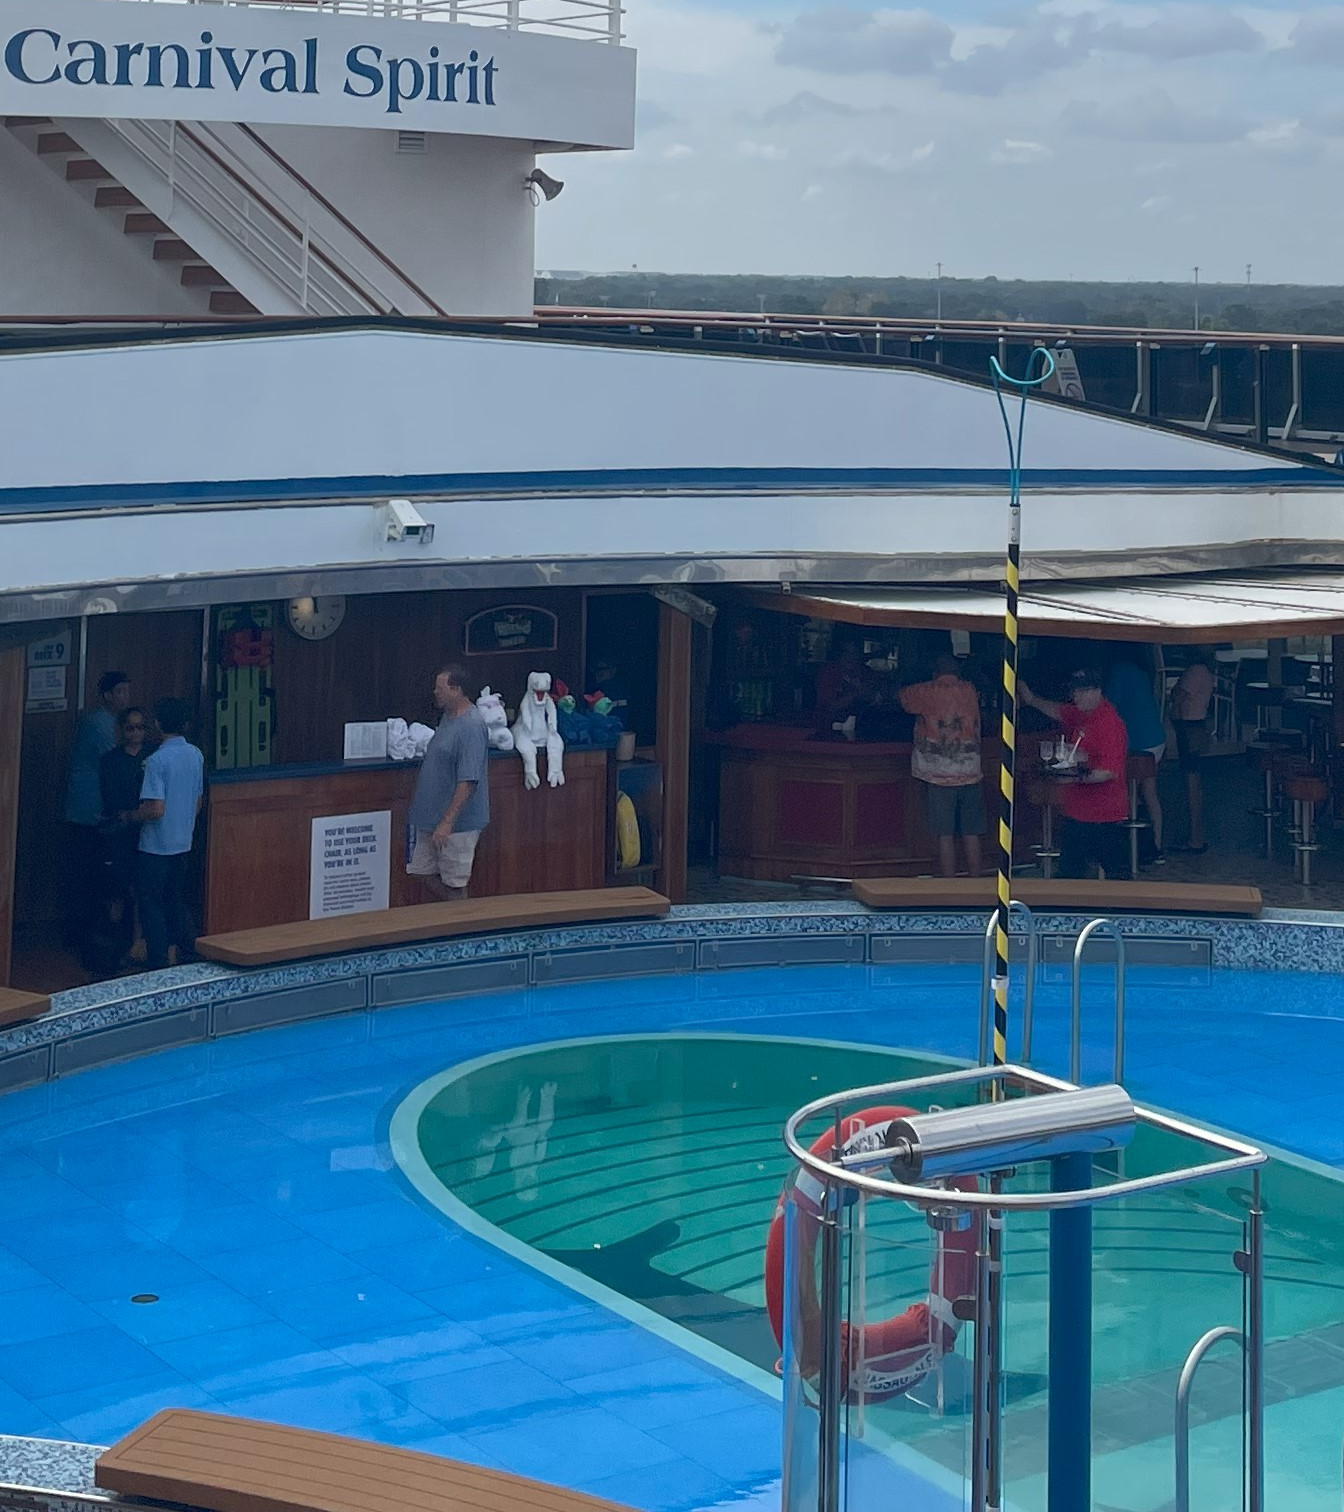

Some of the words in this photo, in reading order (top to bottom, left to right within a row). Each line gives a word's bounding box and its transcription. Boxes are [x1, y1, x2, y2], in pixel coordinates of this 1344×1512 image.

[4, 28, 319, 94] Carnival
[343, 44, 499, 114] Spirit
[56, 642, 65, 659] 9
